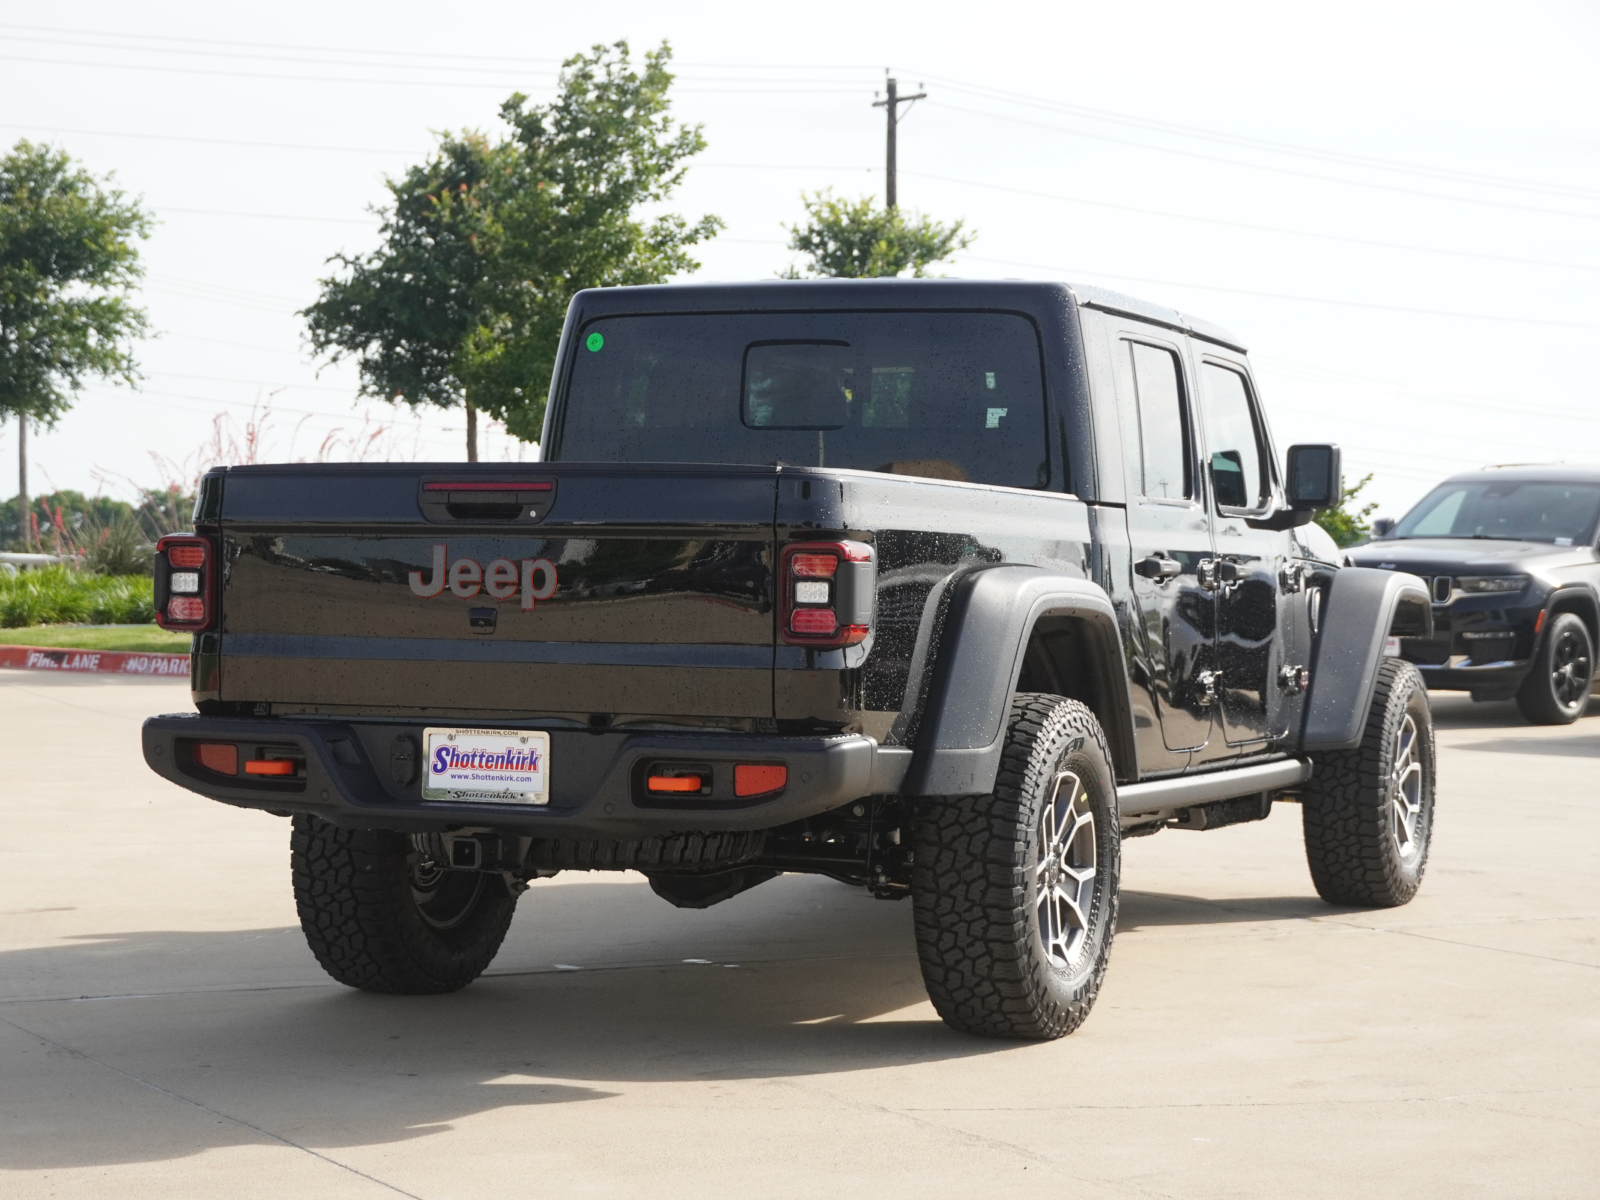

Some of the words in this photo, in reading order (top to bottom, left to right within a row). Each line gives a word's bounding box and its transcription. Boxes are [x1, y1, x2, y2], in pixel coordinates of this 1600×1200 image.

[408, 543, 558, 610] Jeep
[61, 654, 101, 669] LANE
[127, 656, 148, 671] NO
[150, 657, 190, 674] PARK
[432, 745, 540, 774] Shottenkirk
[450, 773, 532, 783] www.Shottenkirk.com
[452, 789, 517, 800] Shottenkirk
